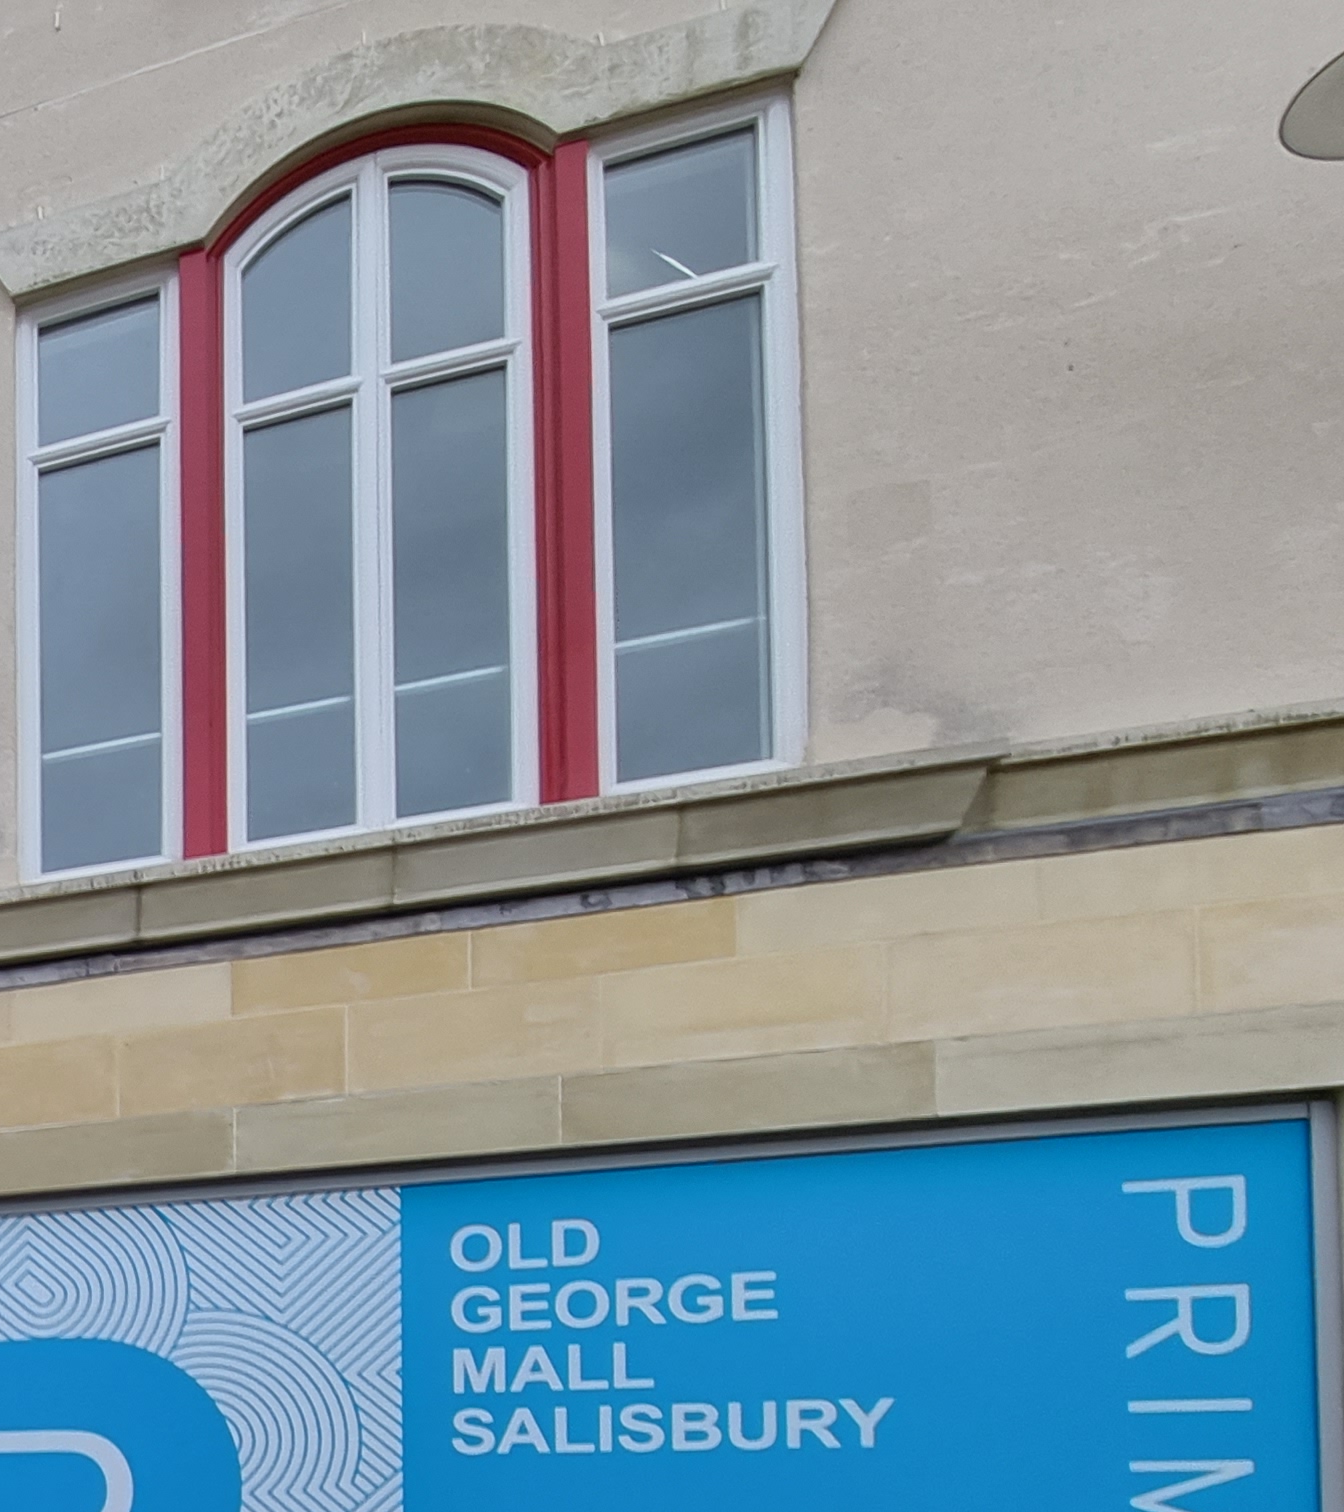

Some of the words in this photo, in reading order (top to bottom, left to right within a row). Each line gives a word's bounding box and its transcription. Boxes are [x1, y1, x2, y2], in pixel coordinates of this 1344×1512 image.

[450, 1218, 601, 1272] OLD
[450, 1270, 779, 1334] GEORGE
[452, 1342, 655, 1394] MALL
[450, 1397, 896, 1456] SALISBURY
